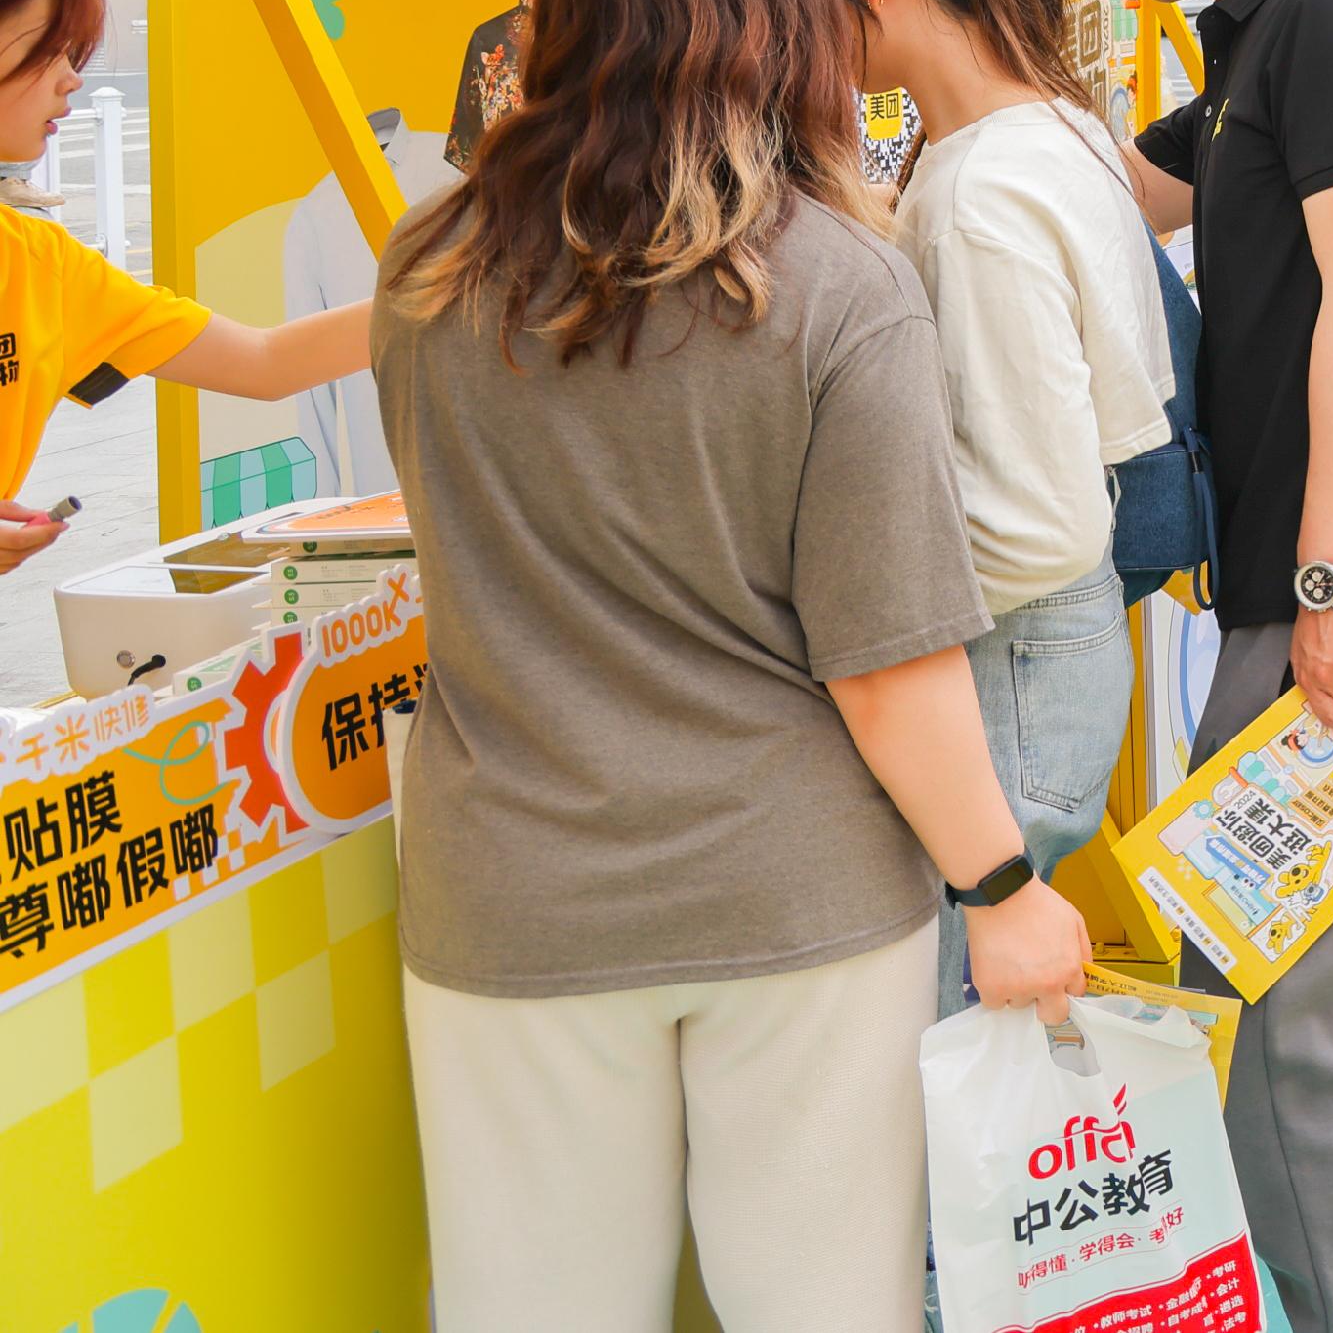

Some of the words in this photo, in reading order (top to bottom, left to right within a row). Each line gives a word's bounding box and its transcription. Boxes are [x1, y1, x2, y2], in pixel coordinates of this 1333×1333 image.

[870, 92, 899, 121] 美团
[20, 693, 151, 771] 千米快修
[321, 664, 428, 772] 保持
[1212, 804, 1292, 874] 美团邀你
[1242, 793, 1313, 858] 逛大集
[0, 804, 219, 959] 尊嘟假嘟
[1013, 1148, 1175, 1247] 中公教育
